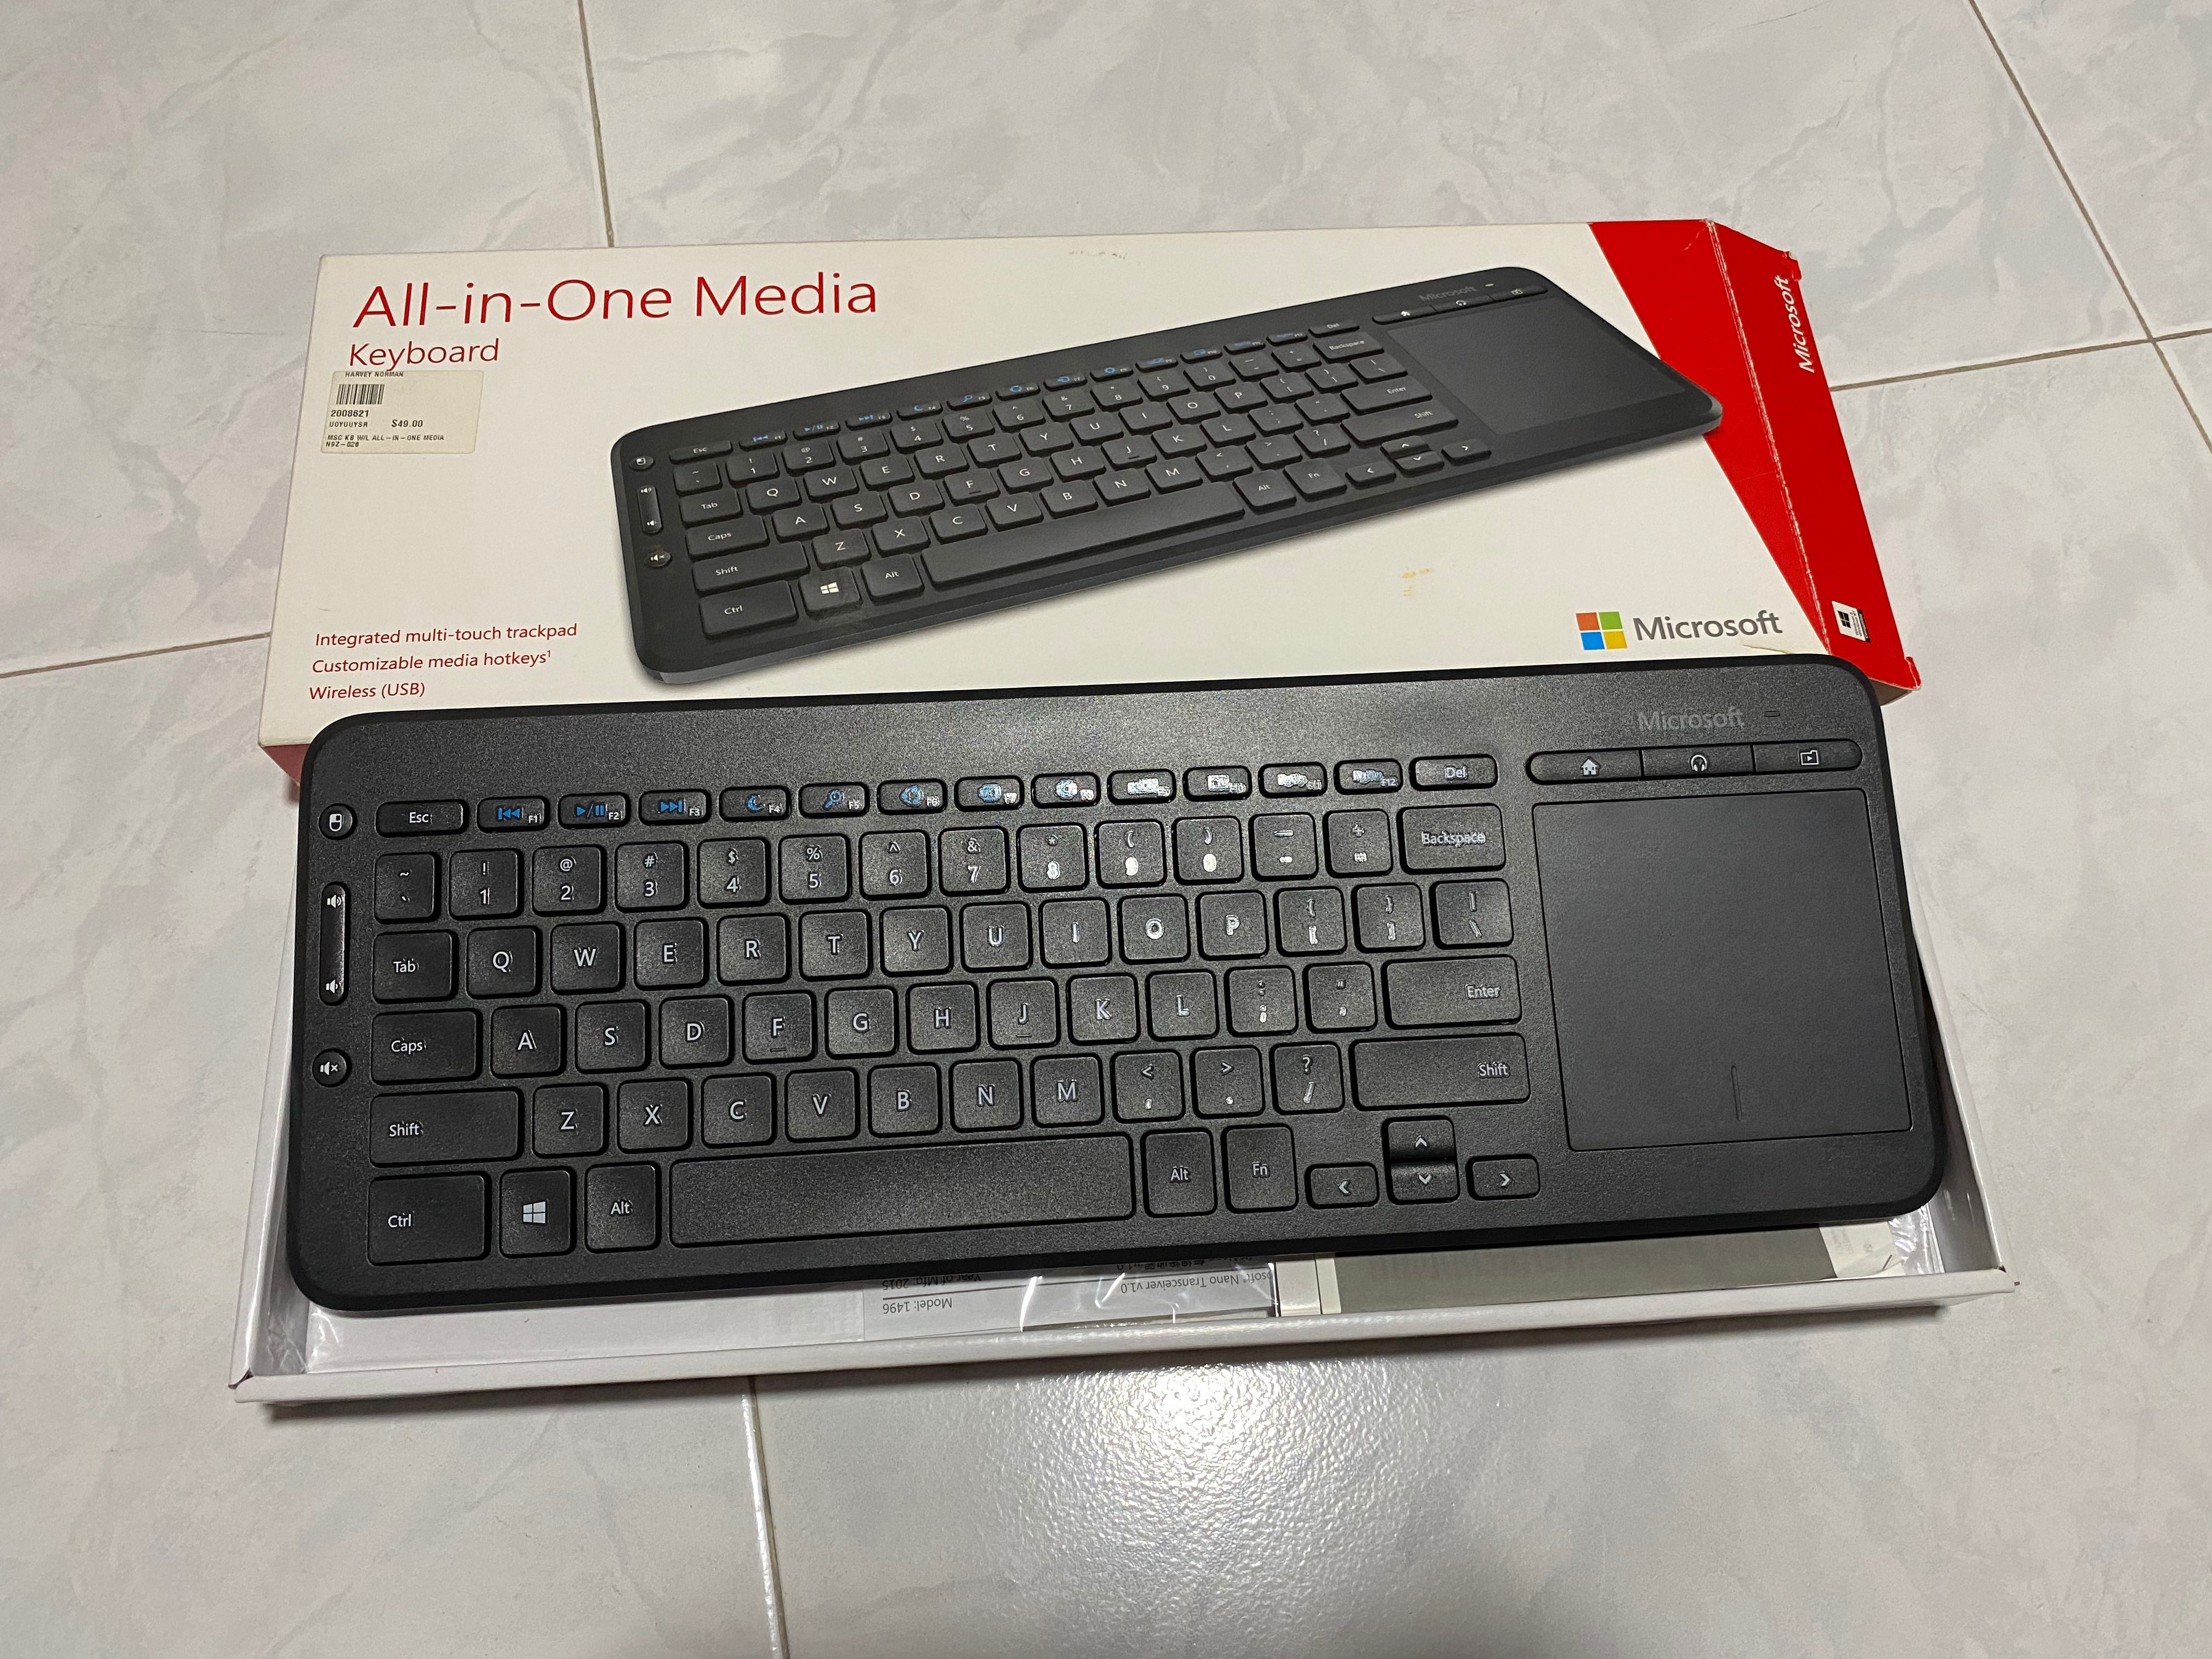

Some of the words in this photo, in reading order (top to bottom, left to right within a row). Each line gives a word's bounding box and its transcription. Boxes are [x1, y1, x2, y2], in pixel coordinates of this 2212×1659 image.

[352, 280, 672, 328] All-in-One
[695, 272, 877, 317] Media
[1420, 285, 1477, 302] Microsoft
[1774, 276, 1815, 373] Microsoft
[1329, 340, 1365, 351] Backspace
[349, 338, 499, 371] Keyboard
[1387, 386, 1407, 394] Enter
[1414, 410, 1433, 419] Shift
[391, 419, 424, 427] $49.00
[1090, 422, 1101, 431] U
[1040, 433, 1048, 441] Y
[1126, 446, 1132, 454] J
[936, 455, 945, 463] R
[882, 466, 891, 474] E
[1019, 469, 1030, 477] G
[1166, 467, 1180, 477] M
[822, 476, 837, 486] W
[966, 480, 974, 488] F
[1115, 480, 1127, 489] N
[766, 488, 778, 498] Q
[910, 492, 921, 500] D
[1063, 492, 1073, 500] B
[854, 504, 862, 512] S
[1007, 503, 1018, 512] V
[795, 516, 806, 525] A
[952, 516, 963, 526] C
[708, 531, 732, 542] Caps
[894, 529, 906, 538] X
[835, 542, 846, 551] Z
[715, 565, 738, 576] Shift
[885, 571, 899, 579] Alt
[724, 605, 743, 614] Ctrl
[1633, 610, 1783, 641] Microsoft
[315, 630, 400, 648] Integrated
[405, 627, 501, 643] multi-touch
[506, 623, 578, 640] trackpad
[312, 656, 423, 673] Customizable
[428, 654, 478, 668] media
[309, 685, 376, 699] Wireless
[381, 682, 426, 699] (USB)
[1638, 706, 1745, 732] Microsoft
[1444, 767, 1468, 780] Del
[608, 811, 621, 820] F2
[689, 808, 702, 816] F3
[769, 804, 782, 814] F4
[409, 812, 431, 823] Esc
[528, 814, 540, 823] F1
[1421, 830, 1486, 847] Backspace
[560, 858, 575, 872] @
[808, 873, 821, 889] 5
[889, 870, 902, 885] 6
[967, 865, 981, 883] 7
[644, 882, 658, 897] 3
[726, 877, 741, 893] 4
[560, 886, 574, 901] 2
[1144, 917, 1165, 940] O
[1226, 914, 1241, 936] P
[908, 930, 924, 951] Y
[988, 926, 1005, 947] U
[745, 939, 761, 958] R
[828, 934, 844, 955] T
[574, 946, 597, 967] W
[663, 943, 678, 963] E
[393, 958, 418, 974] Tab
[493, 951, 513, 973] Q
[1465, 984, 1501, 999] Enter
[1096, 998, 1113, 1020] K
[1176, 995, 1190, 1017] L
[935, 1007, 951, 1029] H
[1018, 1003, 1029, 1025] J
[772, 1017, 786, 1037] F
[852, 1012, 870, 1032] G
[604, 1026, 619, 1046] S
[686, 1022, 706, 1041] D
[391, 1039, 425, 1055] Caps
[518, 1030, 537, 1051] A
[1477, 1062, 1510, 1078] Shift
[977, 1084, 995, 1107] N
[1057, 1079, 1077, 1102] M
[812, 1093, 831, 1115] V
[897, 1089, 913, 1111] B
[644, 1104, 663, 1125] X
[730, 1099, 748, 1121] C
[561, 1109, 578, 1131] Z
[389, 1121, 423, 1137] Shift
[1170, 1166, 1190, 1182] Alt
[1252, 1161, 1269, 1177] Fn
[610, 1200, 633, 1215] Alt
[387, 1211, 414, 1228] Ctrl
[882, 1278, 909, 1290] 2015
[1146, 1278, 1207, 1291] Transceiver
[1210, 1273, 1239, 1285] Nano
[1121, 1281, 1144, 1294] v1.0
[882, 1301, 911, 1314] 1496
[914, 1297, 952, 1312] Model:
